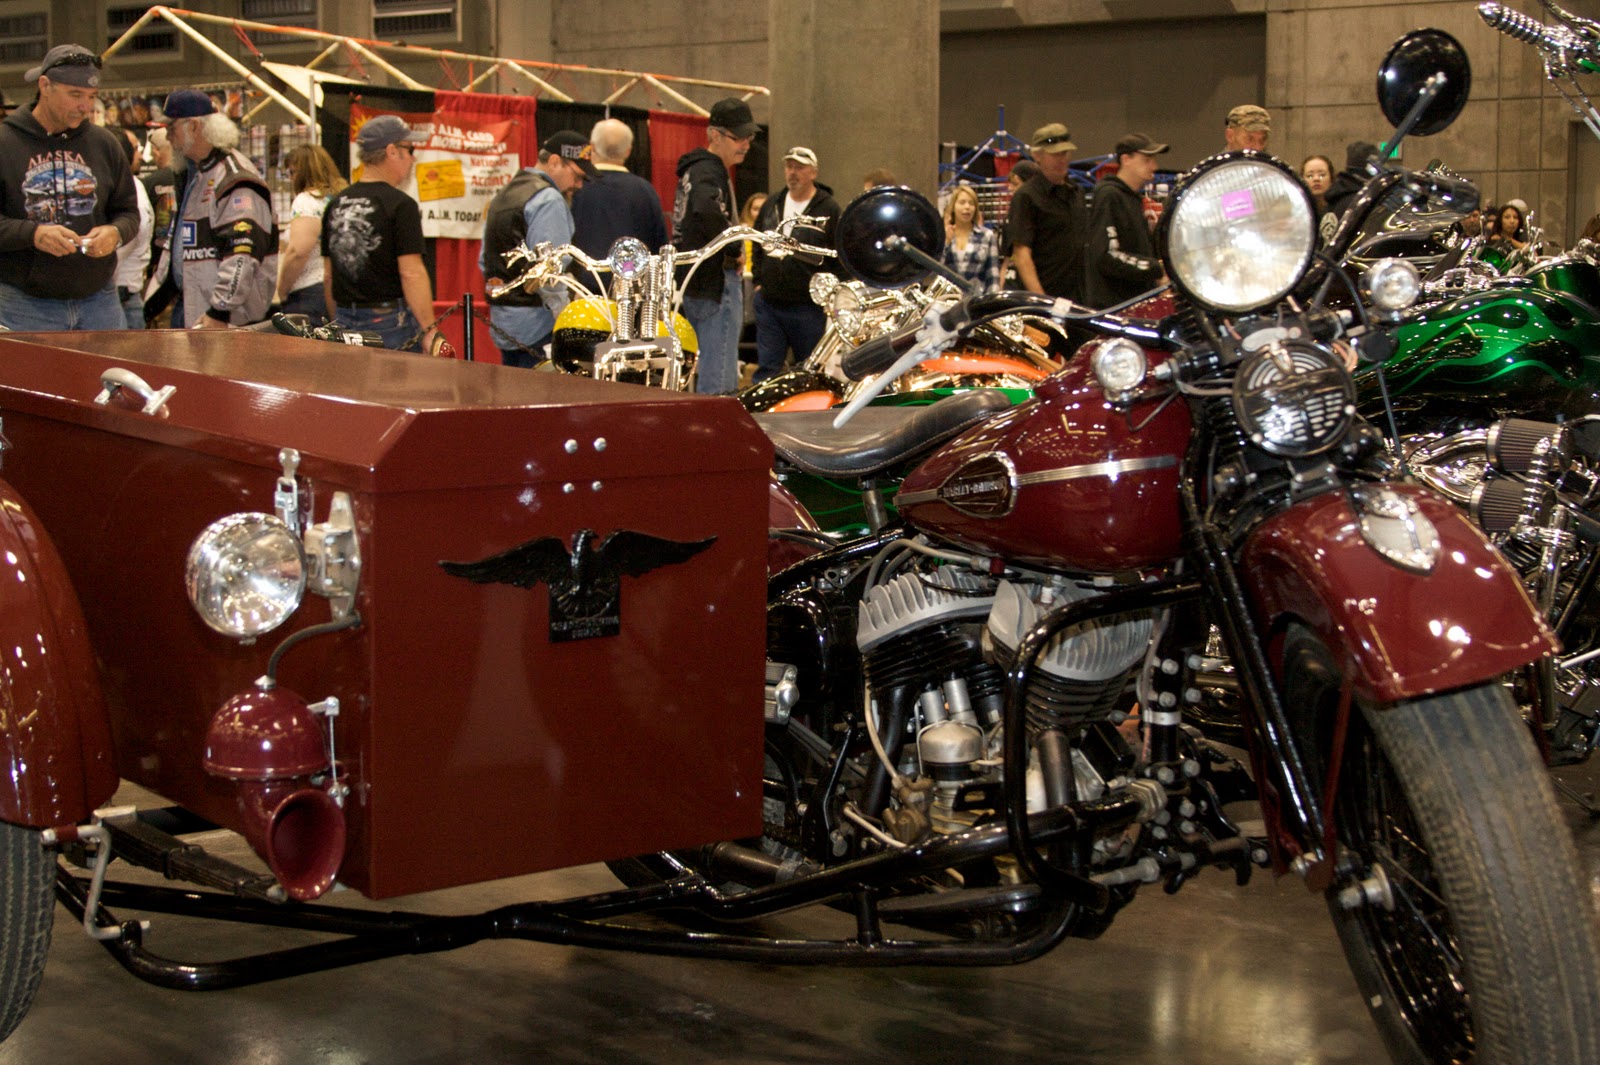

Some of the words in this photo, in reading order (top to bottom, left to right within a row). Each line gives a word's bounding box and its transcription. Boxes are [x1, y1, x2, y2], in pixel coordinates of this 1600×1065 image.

[430, 135, 462, 150] MORE
[28, 150, 86, 170] ALASKA
[455, 210, 482, 222] TODAY
